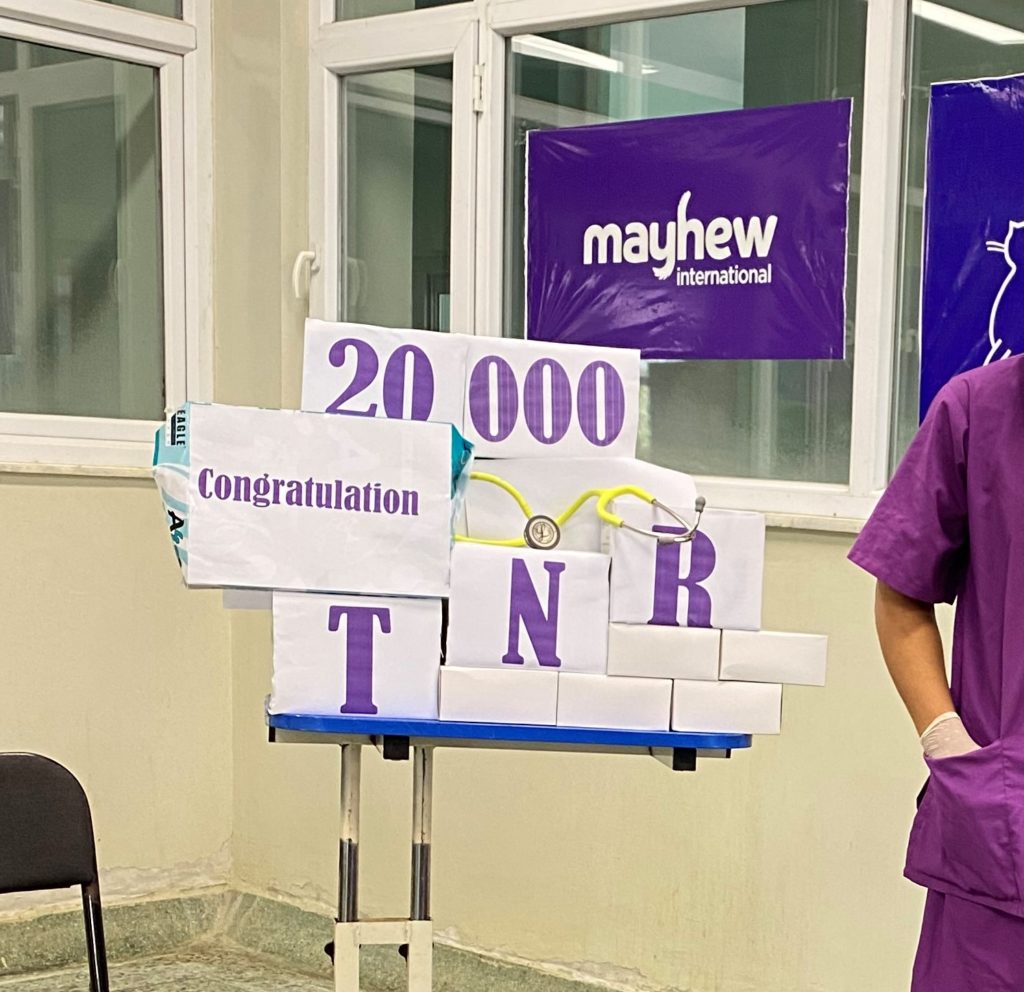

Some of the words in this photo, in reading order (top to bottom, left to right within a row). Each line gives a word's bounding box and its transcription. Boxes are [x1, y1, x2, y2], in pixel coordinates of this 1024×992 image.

[583, 190, 778, 281] mayhew
[676, 263, 772, 286] international
[176, 409, 186, 446] EAGLE
[198, 467, 419, 516] Congratulation
[327, 605, 392, 715] T
[501, 558, 566, 668] N
[647, 524, 717, 629] R
